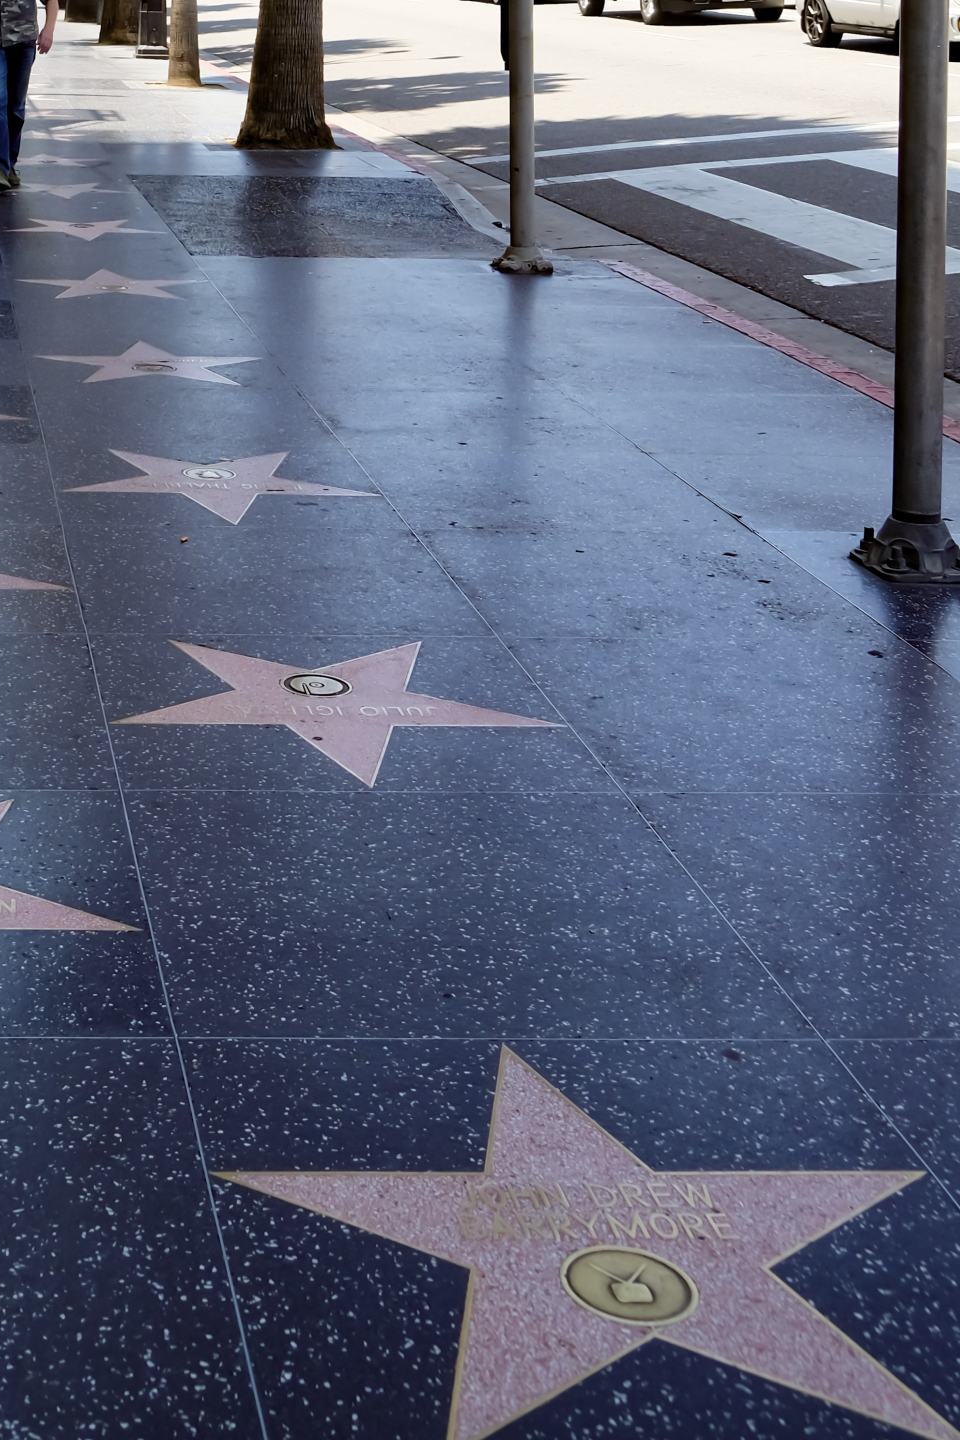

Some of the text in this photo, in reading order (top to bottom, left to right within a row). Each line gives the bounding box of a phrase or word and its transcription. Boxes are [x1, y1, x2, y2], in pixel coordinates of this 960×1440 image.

[358, 704, 440, 718] JULIO
[465, 1182, 717, 1210] JOHN DREW
[456, 1212, 740, 1241] BARRYMORE
